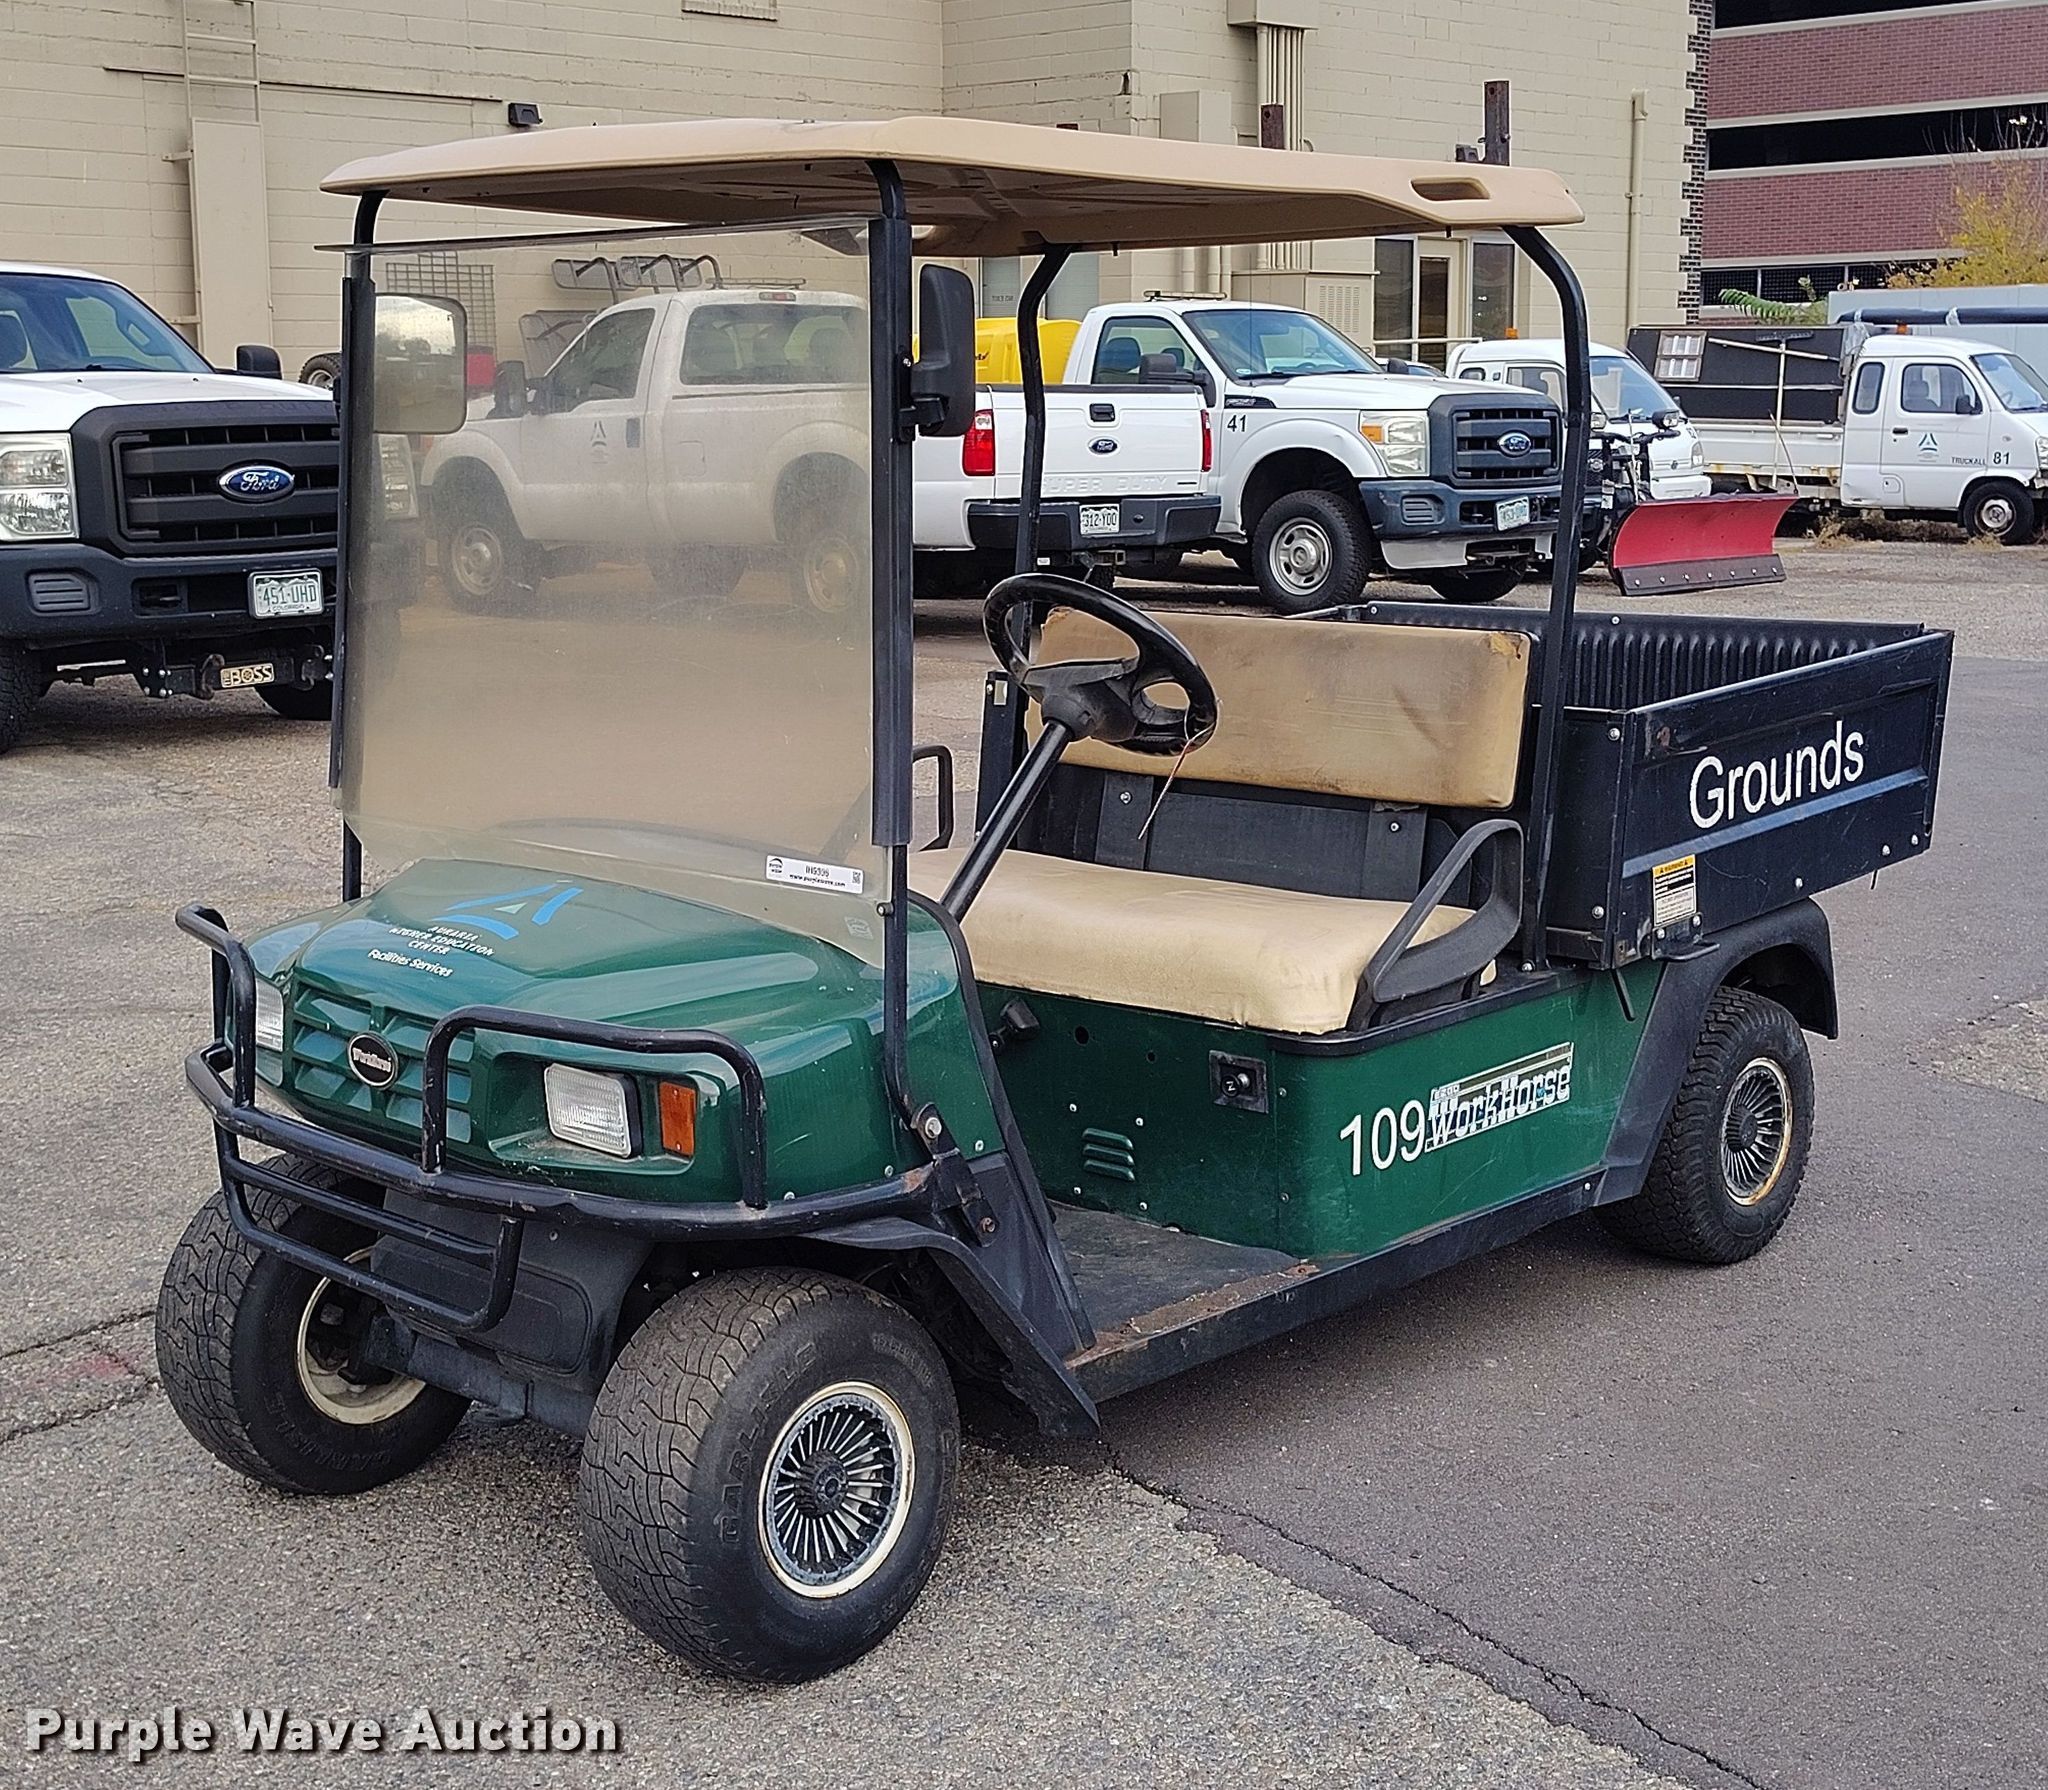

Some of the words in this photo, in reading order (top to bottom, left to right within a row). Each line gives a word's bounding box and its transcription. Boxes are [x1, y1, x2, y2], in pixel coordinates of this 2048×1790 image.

[1227, 414, 1247, 432] 41
[1993, 451, 2010, 465] 81
[239, 470, 280, 491] Ford
[230, 666, 273, 685] BOSS
[1689, 720, 1864, 829] Grounds
[408, 940, 450, 955] CENTER
[431, 935, 495, 956] EDUCATION
[367, 949, 410, 967] Facilities
[409, 957, 453, 977] Services
[1340, 1100, 1426, 1176] 109
